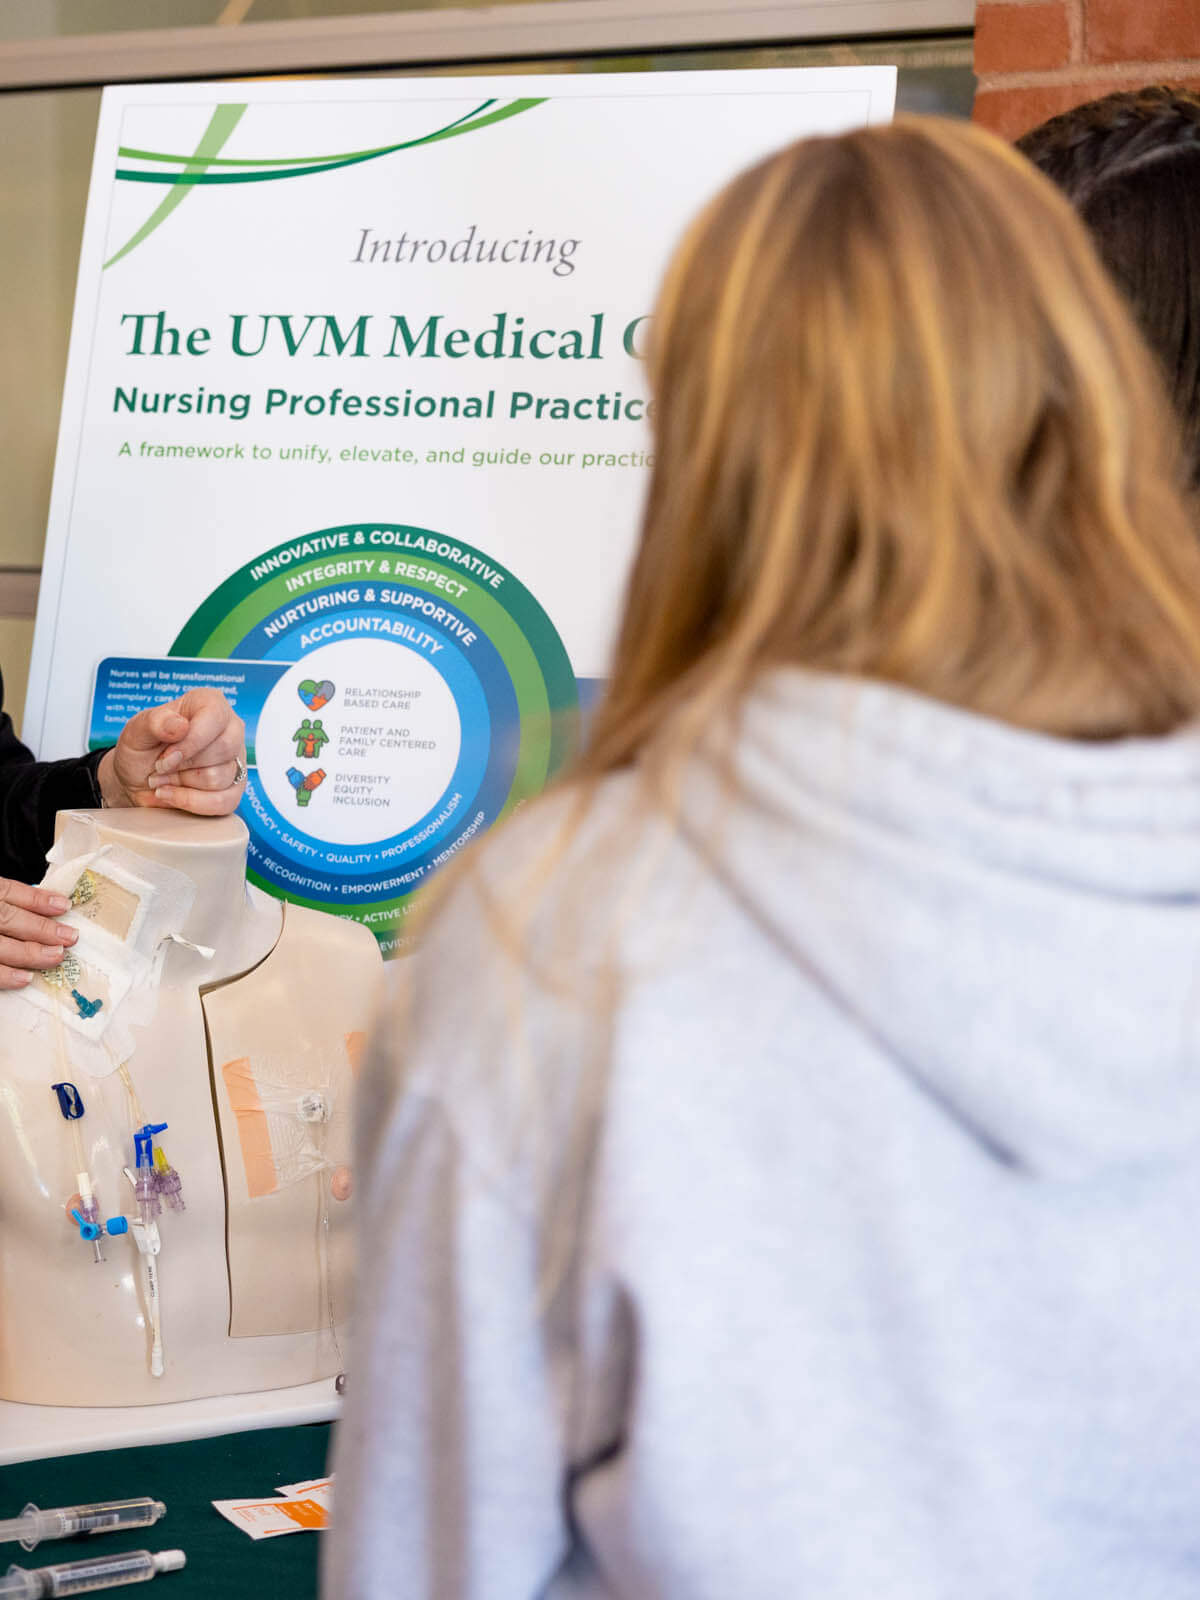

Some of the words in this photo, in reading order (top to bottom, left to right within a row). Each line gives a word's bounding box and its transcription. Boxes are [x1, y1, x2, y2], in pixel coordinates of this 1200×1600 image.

[350, 225, 582, 277] Introducing
[120, 310, 211, 356] The
[229, 314, 374, 357] UVM
[383, 312, 604, 359] Medical
[113, 386, 251, 420] Nursing
[265, 387, 495, 418] Professional
[118, 441, 132, 457] A
[140, 441, 245, 459] framework
[252, 444, 272, 459] to
[279, 444, 332, 464] unify,
[340, 446, 419, 464] elevate,
[426, 448, 465, 463] and
[472, 448, 532, 467] guide
[539, 453, 576, 466] our
[582, 450, 654, 469] practic
[250, 532, 349, 581] INNOVATIVE
[353, 531, 365, 545] &
[369, 530, 505, 589] COLLABORATIVE
[285, 559, 375, 592] INTEGRITY
[379, 560, 391, 574] &
[394, 561, 468, 598] RESPECT
[263, 589, 360, 639] NURTURING
[364, 588, 376, 602] &
[380, 589, 477, 646] SUPPORTIVE
[300, 617, 443, 655] ACCOUNTABILITY
[110, 669, 139, 678] Nurses
[159, 671, 170, 679] be
[172, 672, 245, 683] transformational
[109, 680, 140, 689] leaders
[142, 682, 152, 690] of
[154, 682, 180, 692] highly
[345, 687, 422, 699] RELATIONSHIP
[343, 698, 379, 708] BASED
[382, 700, 411, 710] CARE
[340, 725, 384, 736] PATIENT
[386, 728, 410, 738] AND
[339, 737, 377, 747] FAMILY
[379, 738, 437, 750] CENTERED
[338, 747, 366, 757] CARE
[335, 773, 391, 785] DIVERSITY
[333, 784, 373, 795] EQUITY
[332, 795, 391, 807] INCLUSION
[280, 832, 319, 857] SAFETY
[326, 852, 372, 864] QUALITY
[381, 792, 463, 859] PROFESSIONALISM
[263, 857, 331, 893] RECOGNITION
[341, 866, 425, 894] EMPOWERMENT
[432, 811, 486, 867] MENTORSHIP
[363, 907, 401, 923] ACTIVE
